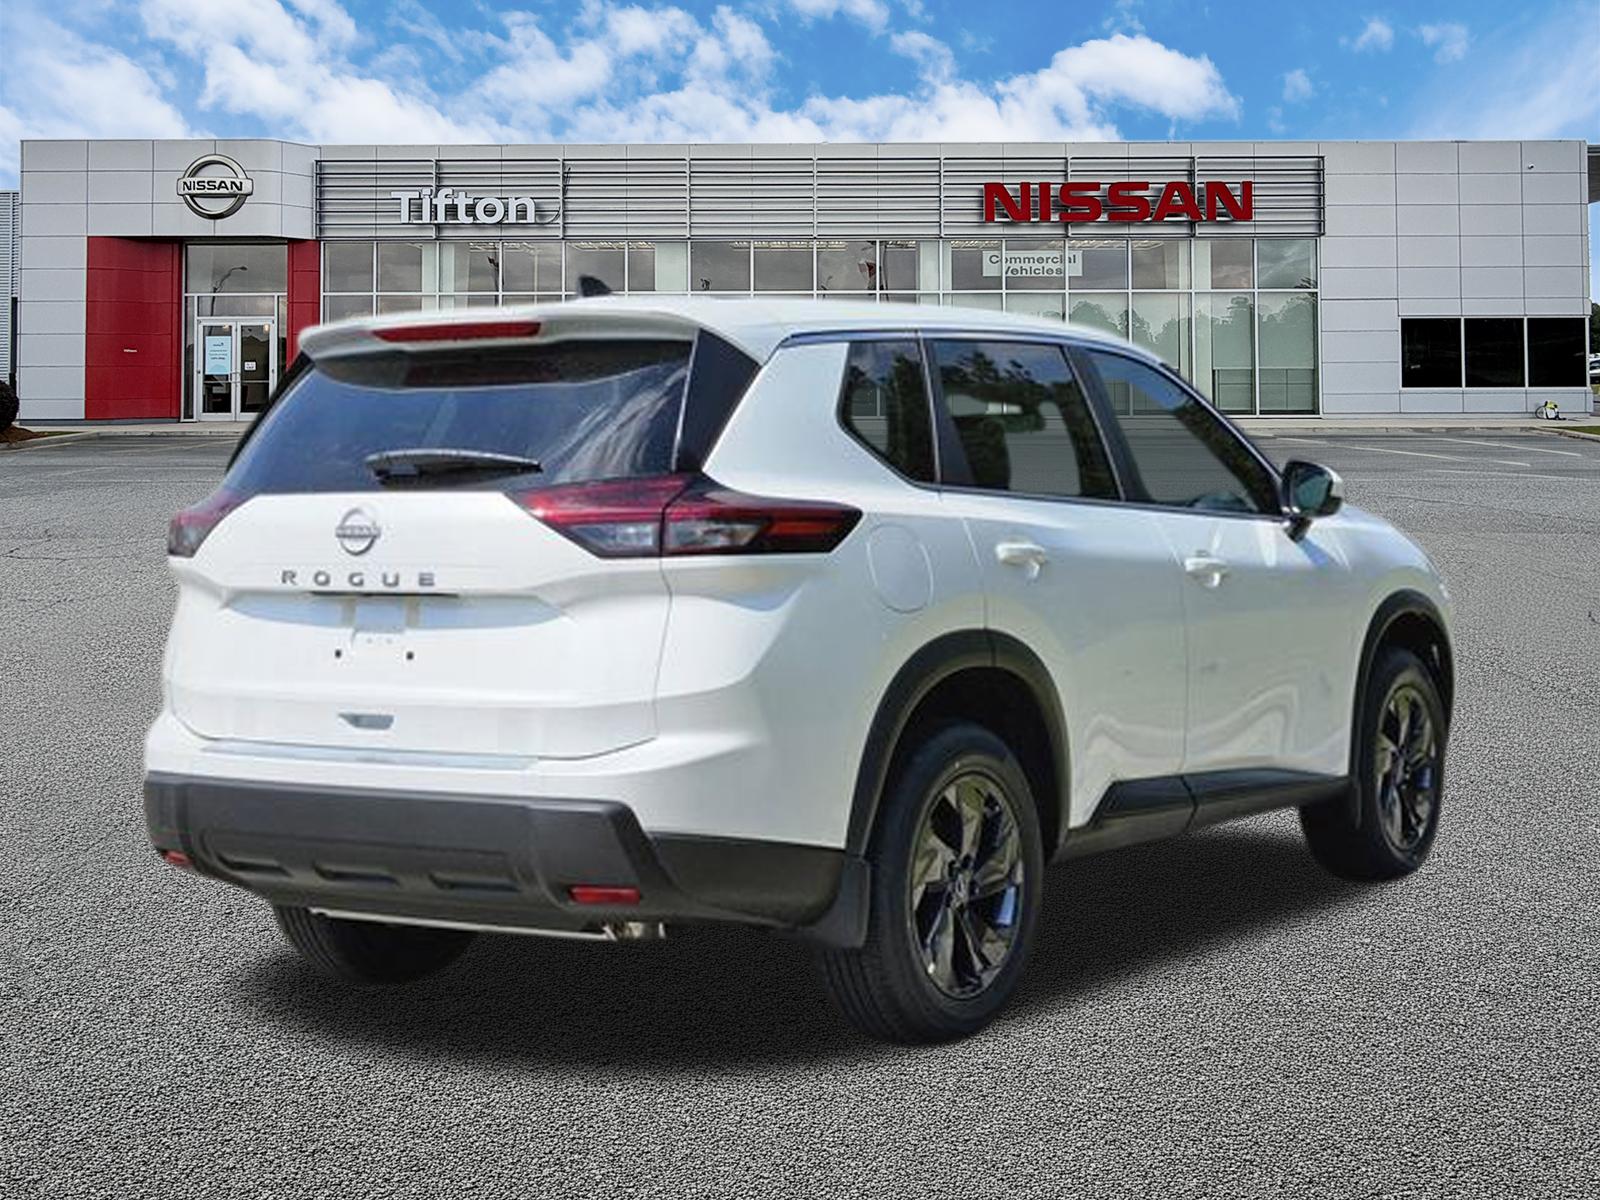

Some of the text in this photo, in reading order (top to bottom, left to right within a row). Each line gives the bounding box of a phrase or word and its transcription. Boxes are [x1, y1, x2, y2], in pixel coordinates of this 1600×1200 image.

[183, 180, 243, 191] NISSAN
[391, 188, 536, 223] Tifton
[984, 181, 1253, 222] NISSAN
[281, 570, 435, 587] ROGUE
